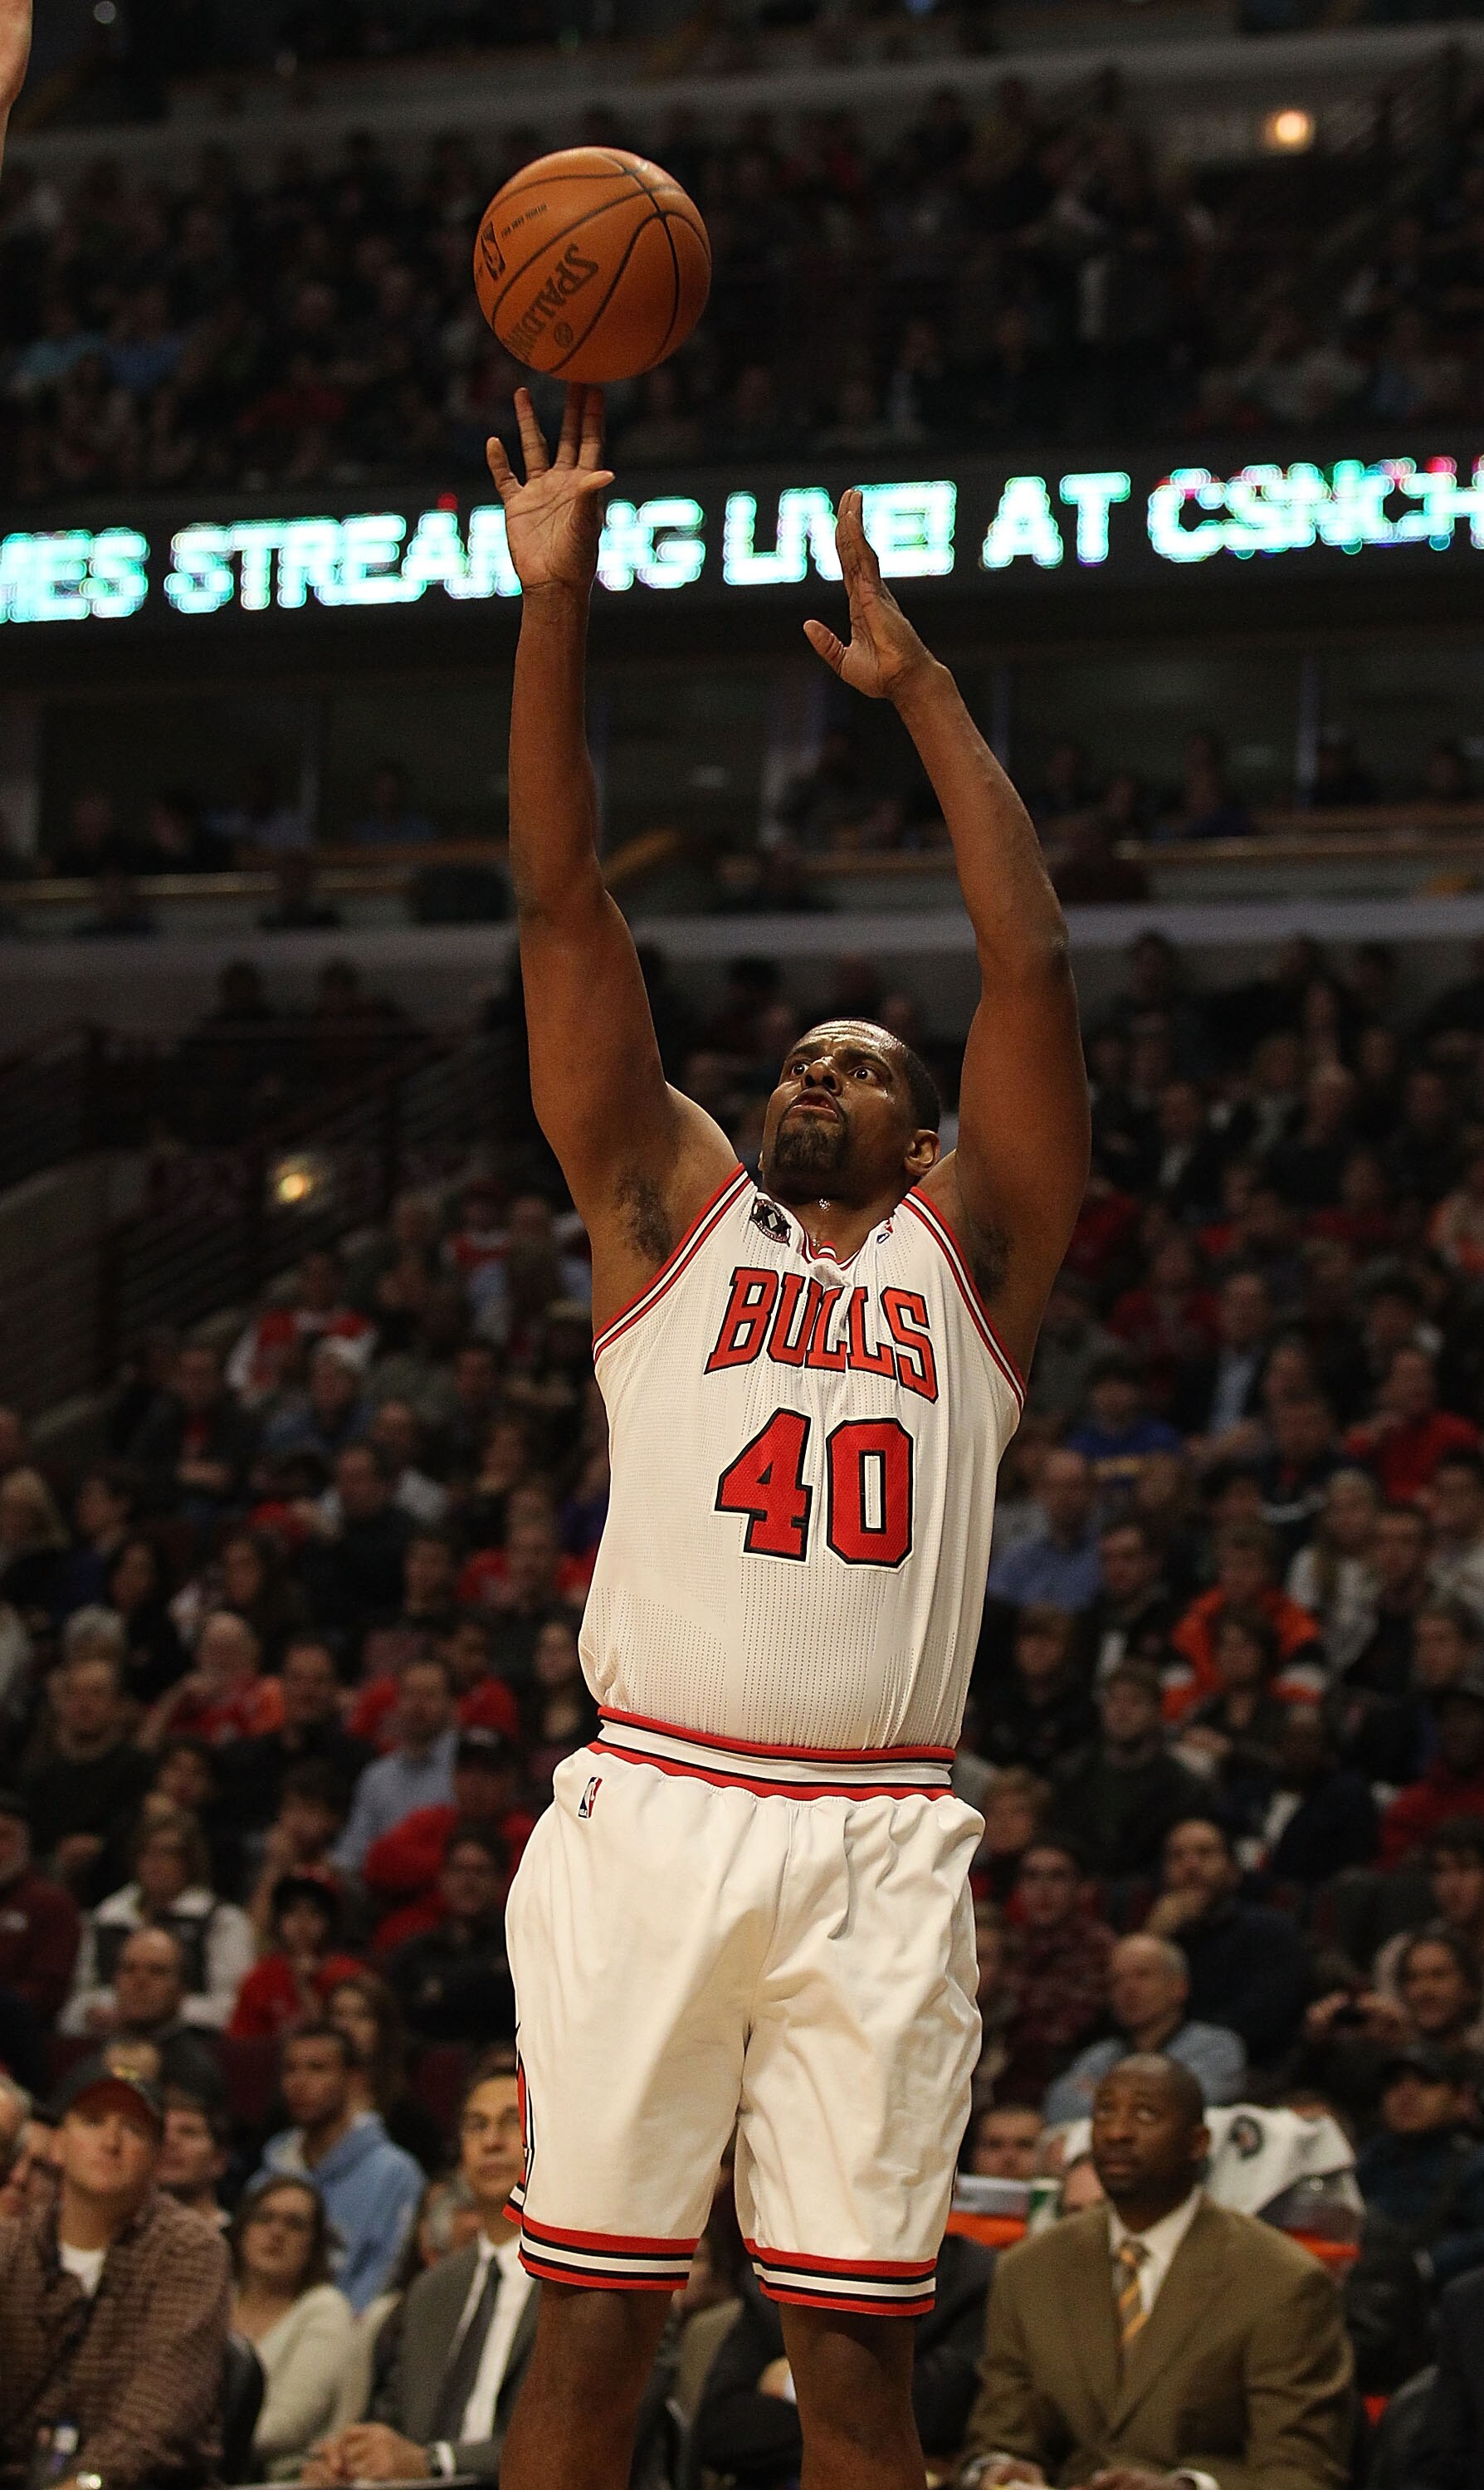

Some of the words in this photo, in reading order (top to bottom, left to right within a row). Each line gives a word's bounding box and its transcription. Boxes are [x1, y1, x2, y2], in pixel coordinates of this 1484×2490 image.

[982, 471, 1131, 569] AT
[704, 1266, 940, 1404] BULLS
[712, 1407, 915, 1571] 40
